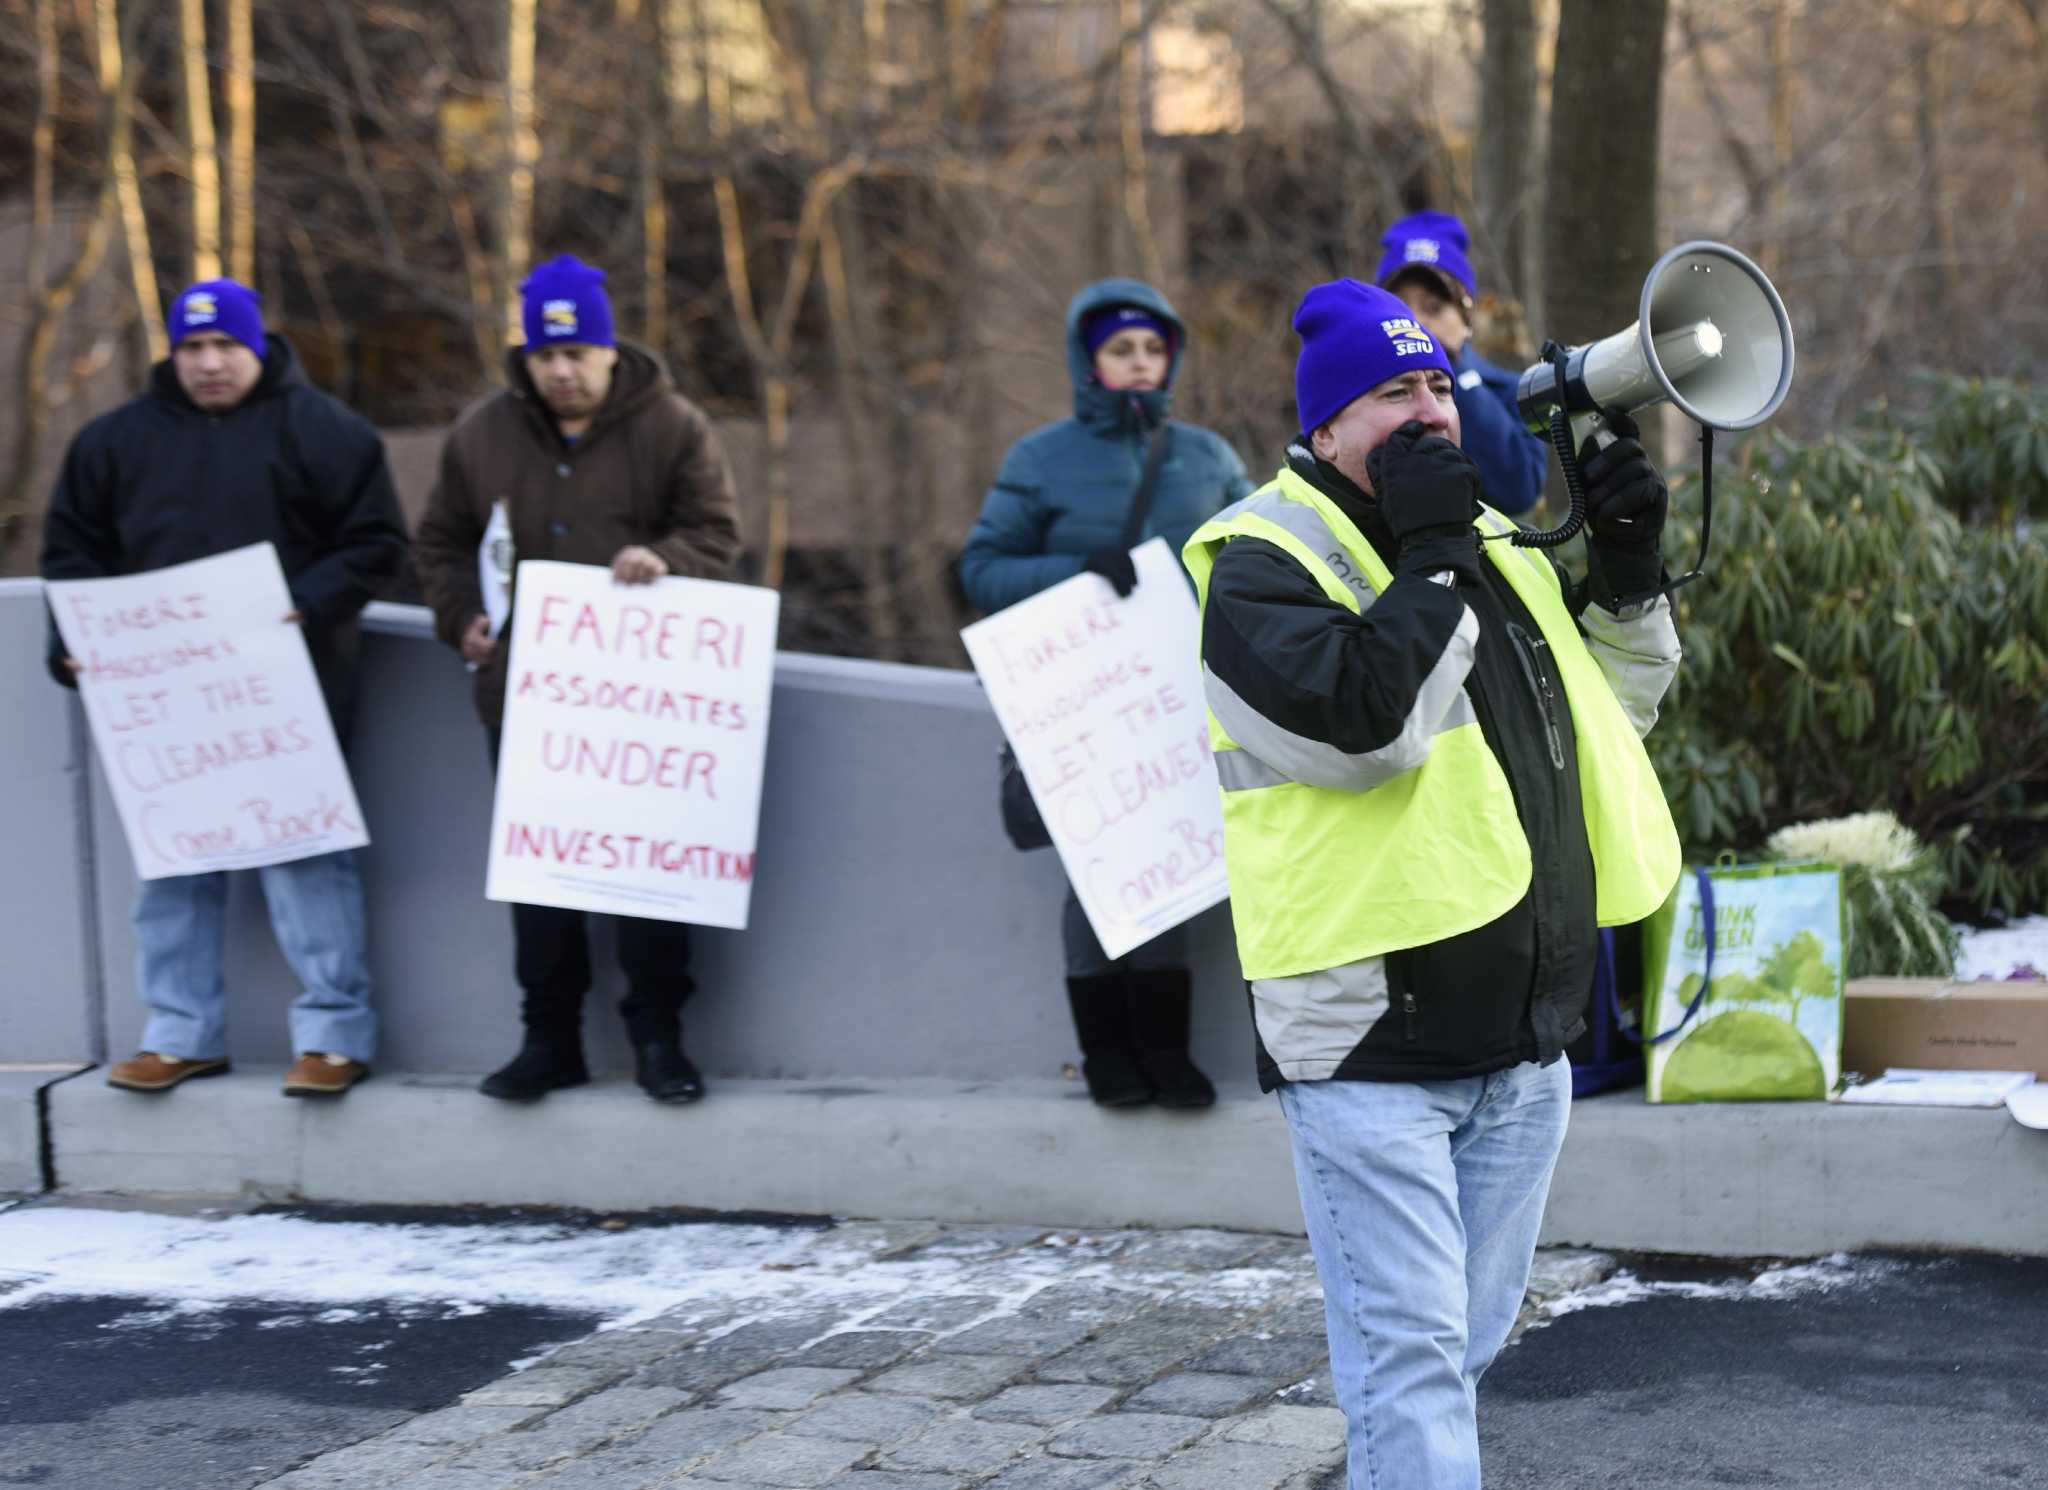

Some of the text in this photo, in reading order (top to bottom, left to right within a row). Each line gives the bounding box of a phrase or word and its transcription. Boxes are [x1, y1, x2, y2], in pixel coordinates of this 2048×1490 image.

[1396, 341, 1434, 356] SEIU
[534, 595, 746, 669] FARERI
[102, 672, 273, 732] LET THE
[516, 671, 748, 731] ASSOCIATES
[1115, 683, 1187, 735] THE
[541, 731, 719, 801] UNDER
[1688, 903, 1757, 927] TINK
